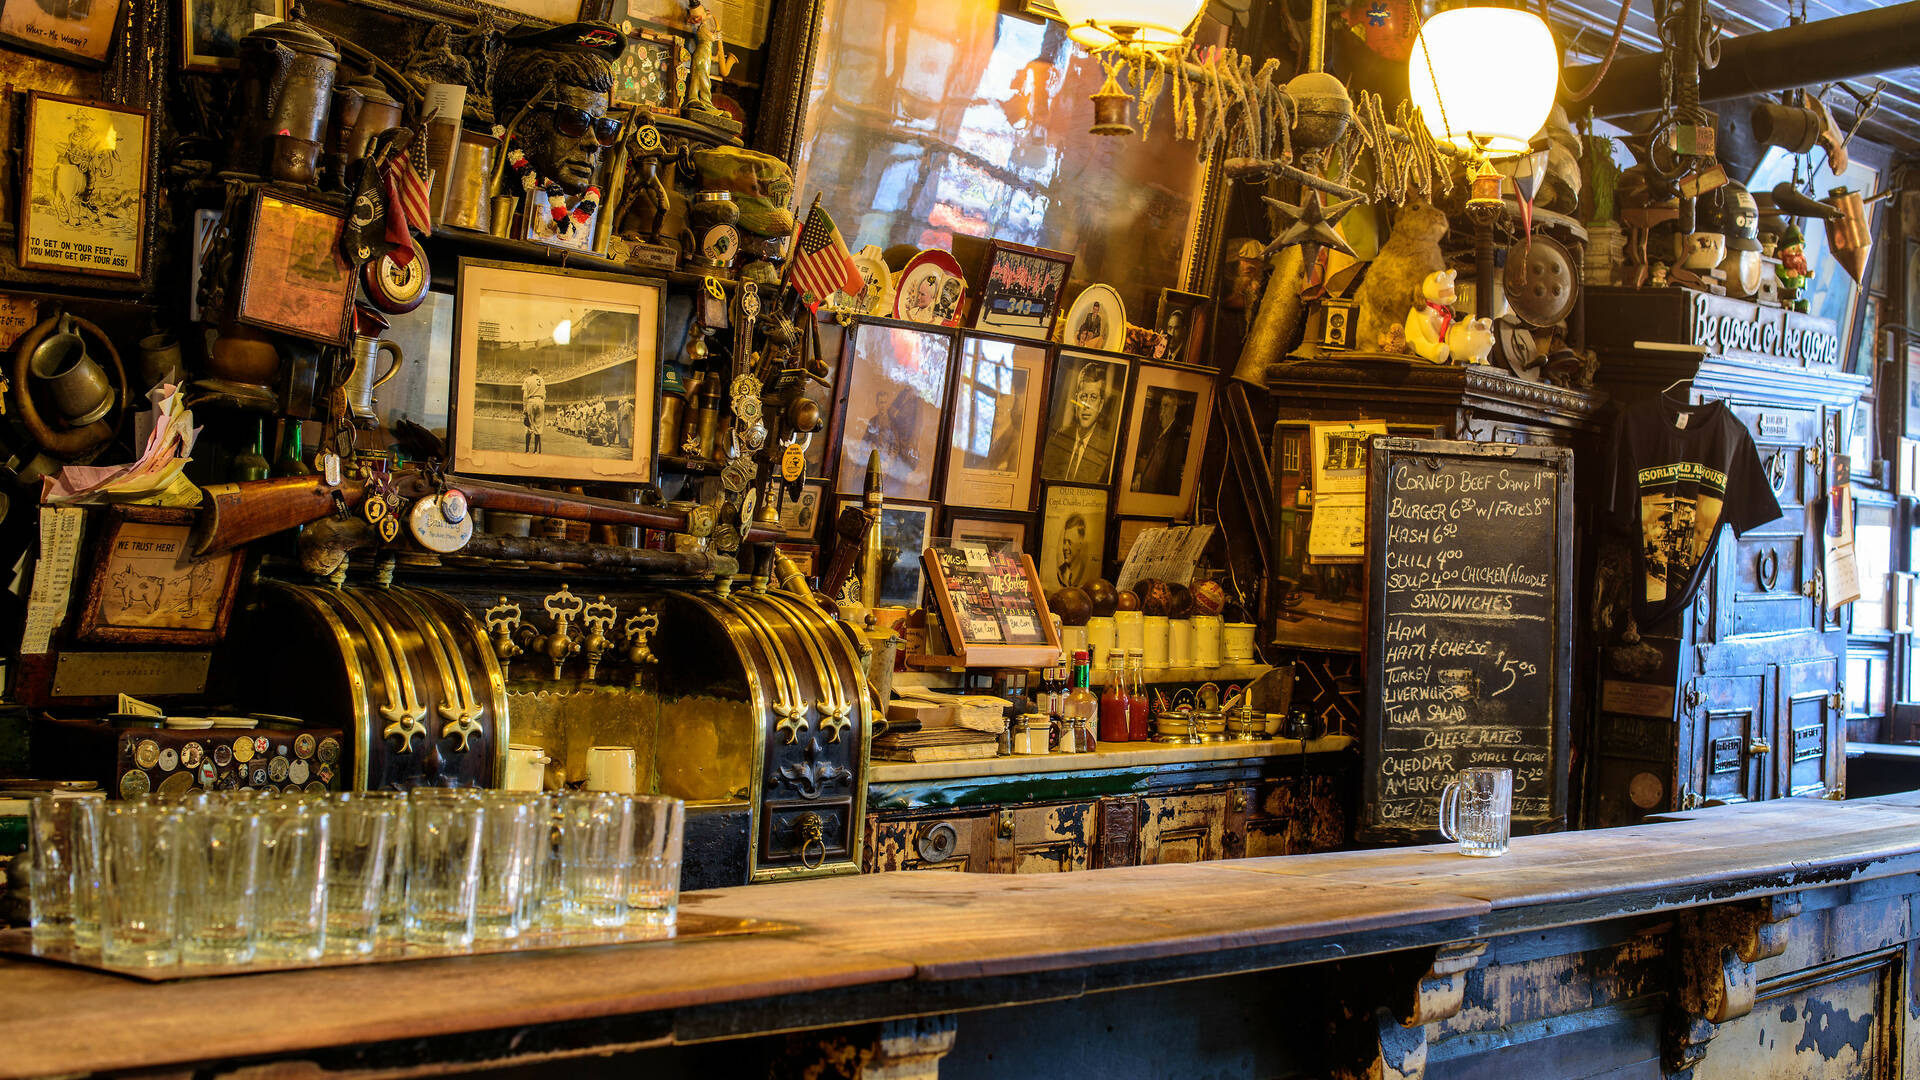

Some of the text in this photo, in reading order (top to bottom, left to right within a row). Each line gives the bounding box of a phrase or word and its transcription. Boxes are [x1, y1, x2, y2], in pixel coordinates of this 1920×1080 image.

[30, 237, 41, 246] TO
[43, 239, 58, 248] GET
[61, 241, 71, 250] ON
[73, 243, 92, 253] YOUR
[30, 246, 128, 267] YOU MUST GET OFF YOUR ASS!
[1007, 297, 1033, 315] 343
[1695, 292, 1838, 369] Be good or be gone
[535, 378, 542, 387] 3
[1395, 466, 1455, 493] CORNED
[1459, 470, 1494, 493] BEEF
[1389, 497, 1447, 521] BURGER
[1388, 524, 1429, 545] HASH
[118, 540, 176, 553] WE TRUST HERE
[1386, 552, 1431, 569] CHILI
[987, 573, 1029, 597] McSorley
[1387, 572, 1430, 589] SOUP
[1461, 563, 1513, 585] CHICKEN
[1511, 565, 1549, 587] NOODLE
[1001, 606, 1036, 616] POEMS
[1410, 593, 1513, 611] SANDWICHES
[1386, 620, 1426, 642] HAM
[1385, 643, 1426, 663] HAM
[1439, 639, 1492, 657] CHEESE
[1385, 665, 1432, 685] TURKEY
[1385, 704, 1467, 724] TUNA SALAD
[1424, 730, 1523, 748] CHEESE PLATES
[1382, 754, 1455, 776] CHEDDAR
[1469, 751, 1508, 763] SMALL
